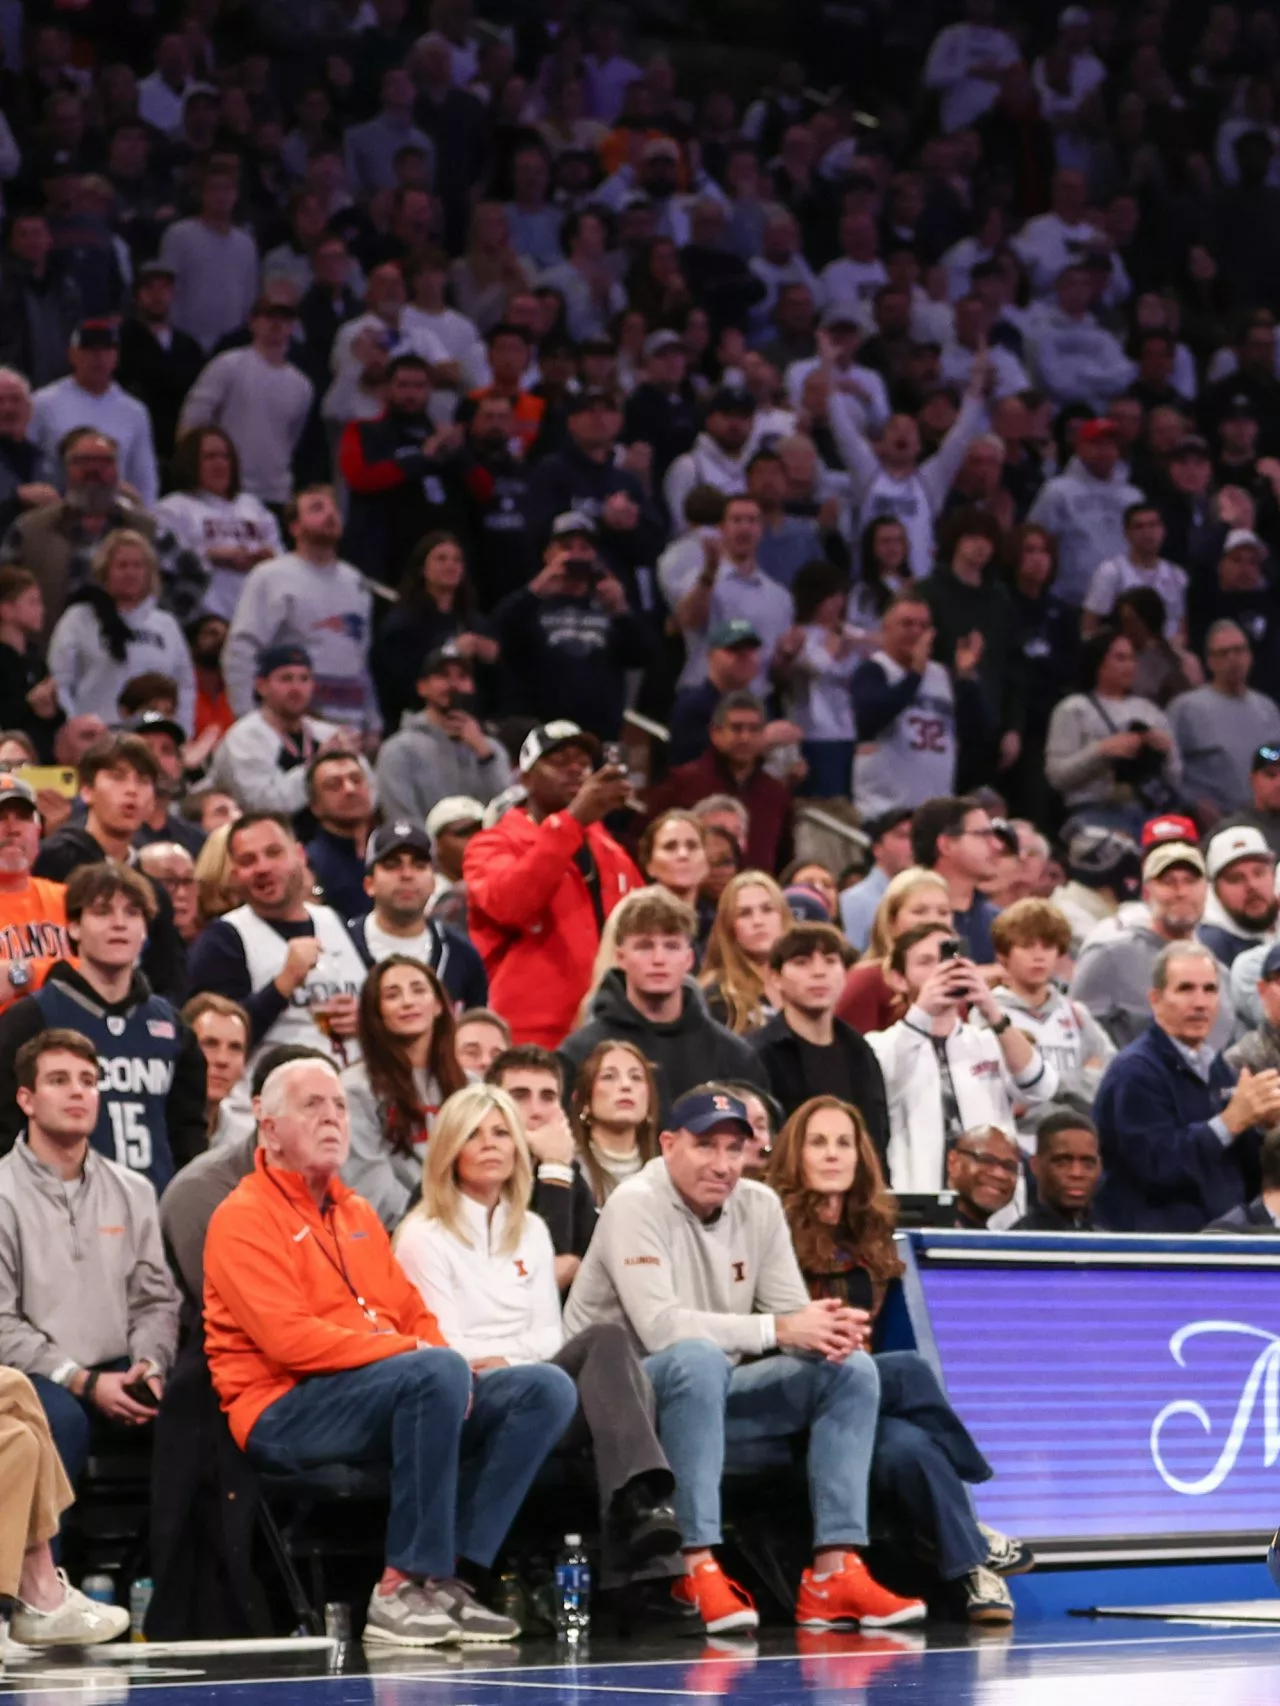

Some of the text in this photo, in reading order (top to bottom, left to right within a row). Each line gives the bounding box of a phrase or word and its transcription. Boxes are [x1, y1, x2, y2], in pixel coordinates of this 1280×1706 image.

[907, 715, 947, 753] 32
[96, 1056, 174, 1095] CONN
[107, 1100, 153, 1169] 15
